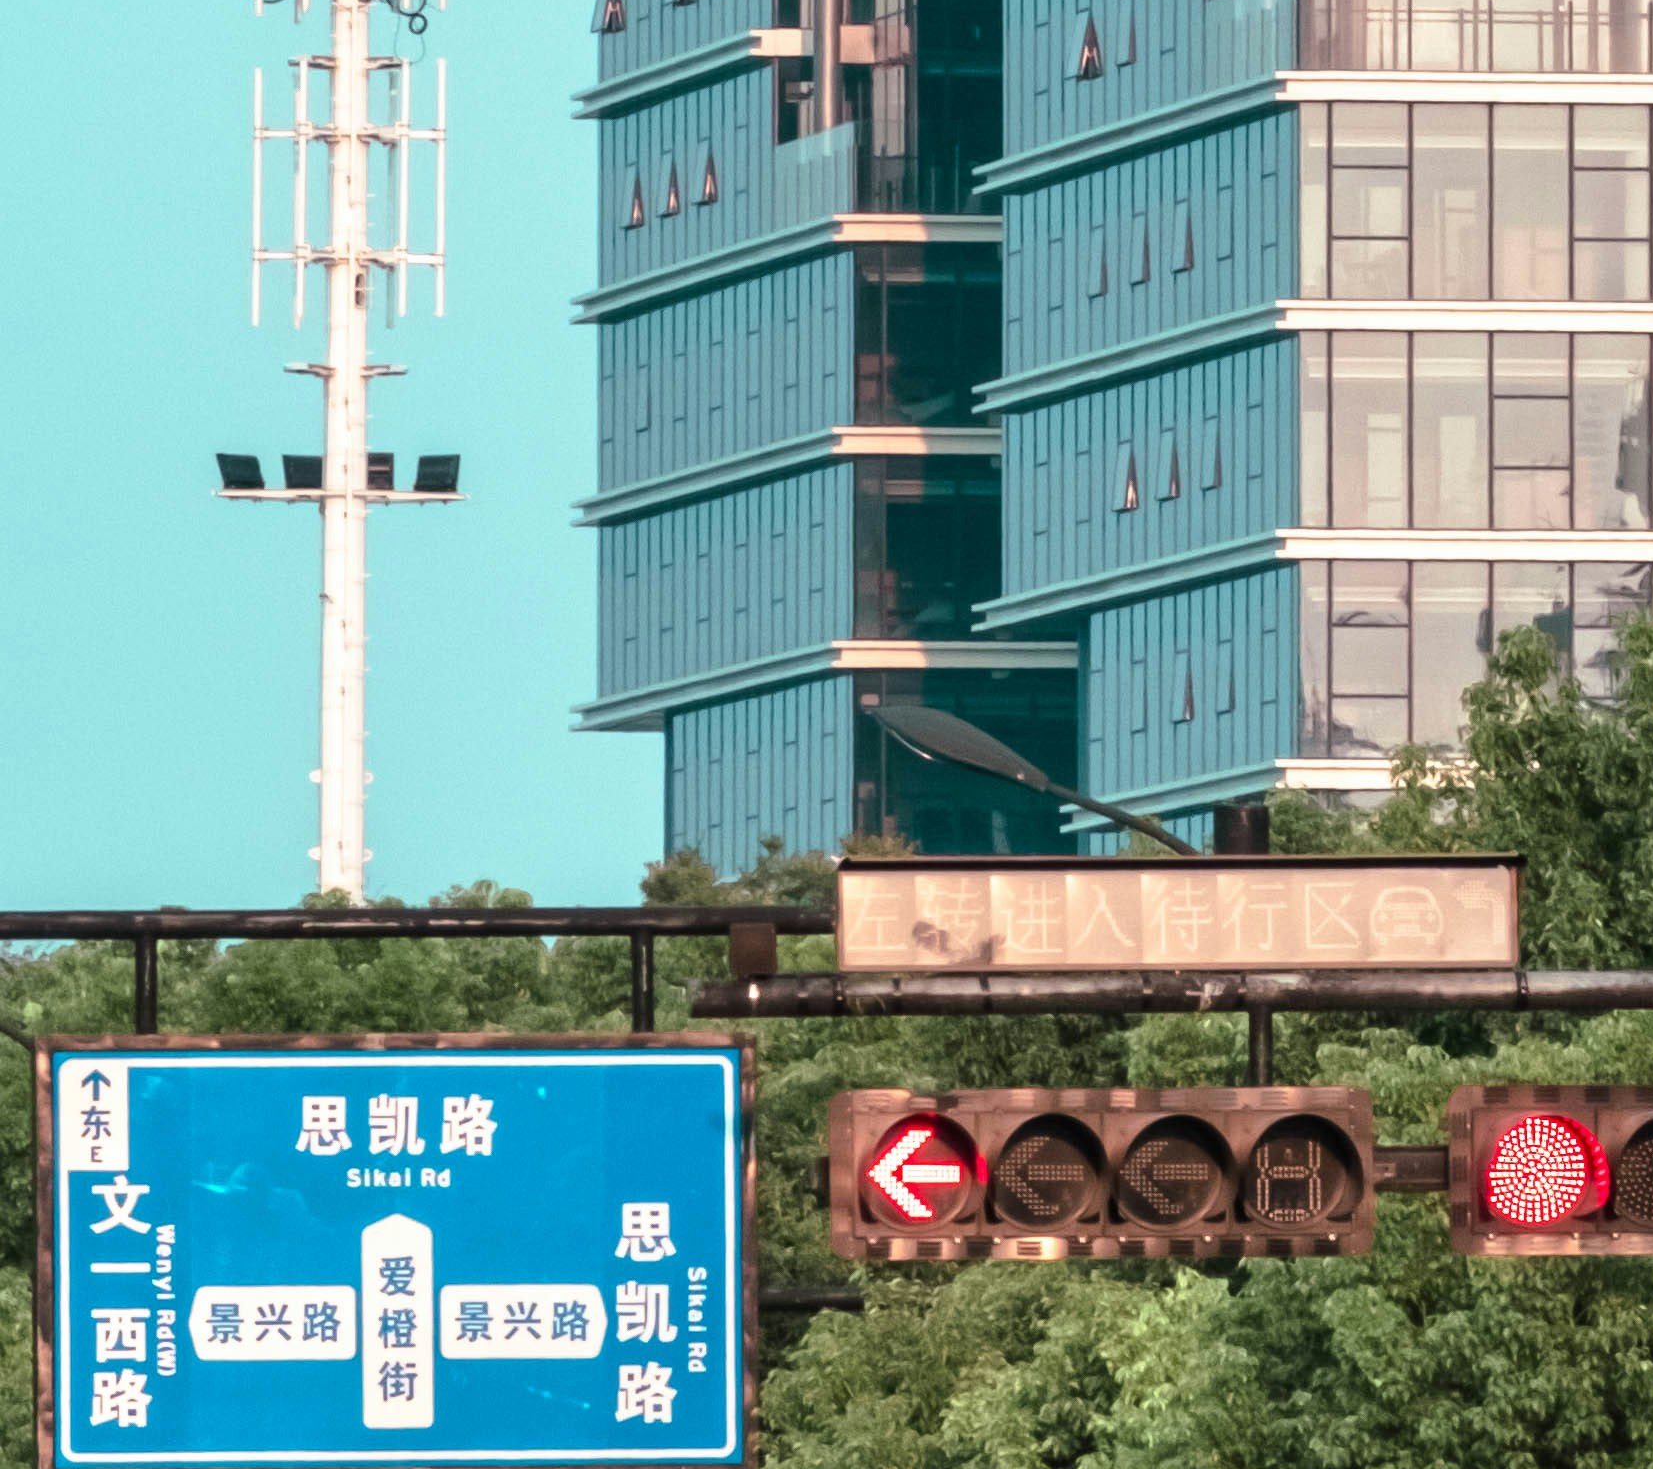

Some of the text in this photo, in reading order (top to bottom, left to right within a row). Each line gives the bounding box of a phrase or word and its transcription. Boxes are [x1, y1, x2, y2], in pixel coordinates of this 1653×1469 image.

[843, 871, 1362, 955] 左转进入待行区
[80, 1106, 113, 1141] 东
[91, 1146, 104, 1163] E
[295, 1093, 498, 1157] 思凯路
[346, 1167, 451, 1188] Sikai Rd
[152, 1224, 176, 1301] Wenyi
[89, 1175, 152, 1428] 文一西路
[205, 1302, 342, 1344] 景兴路
[377, 1255, 418, 1402] 爱橙街
[455, 1301, 590, 1343] 景兴路
[614, 1201, 678, 1424] 思凯路
[687, 1266, 708, 1373] Sikai Rd
